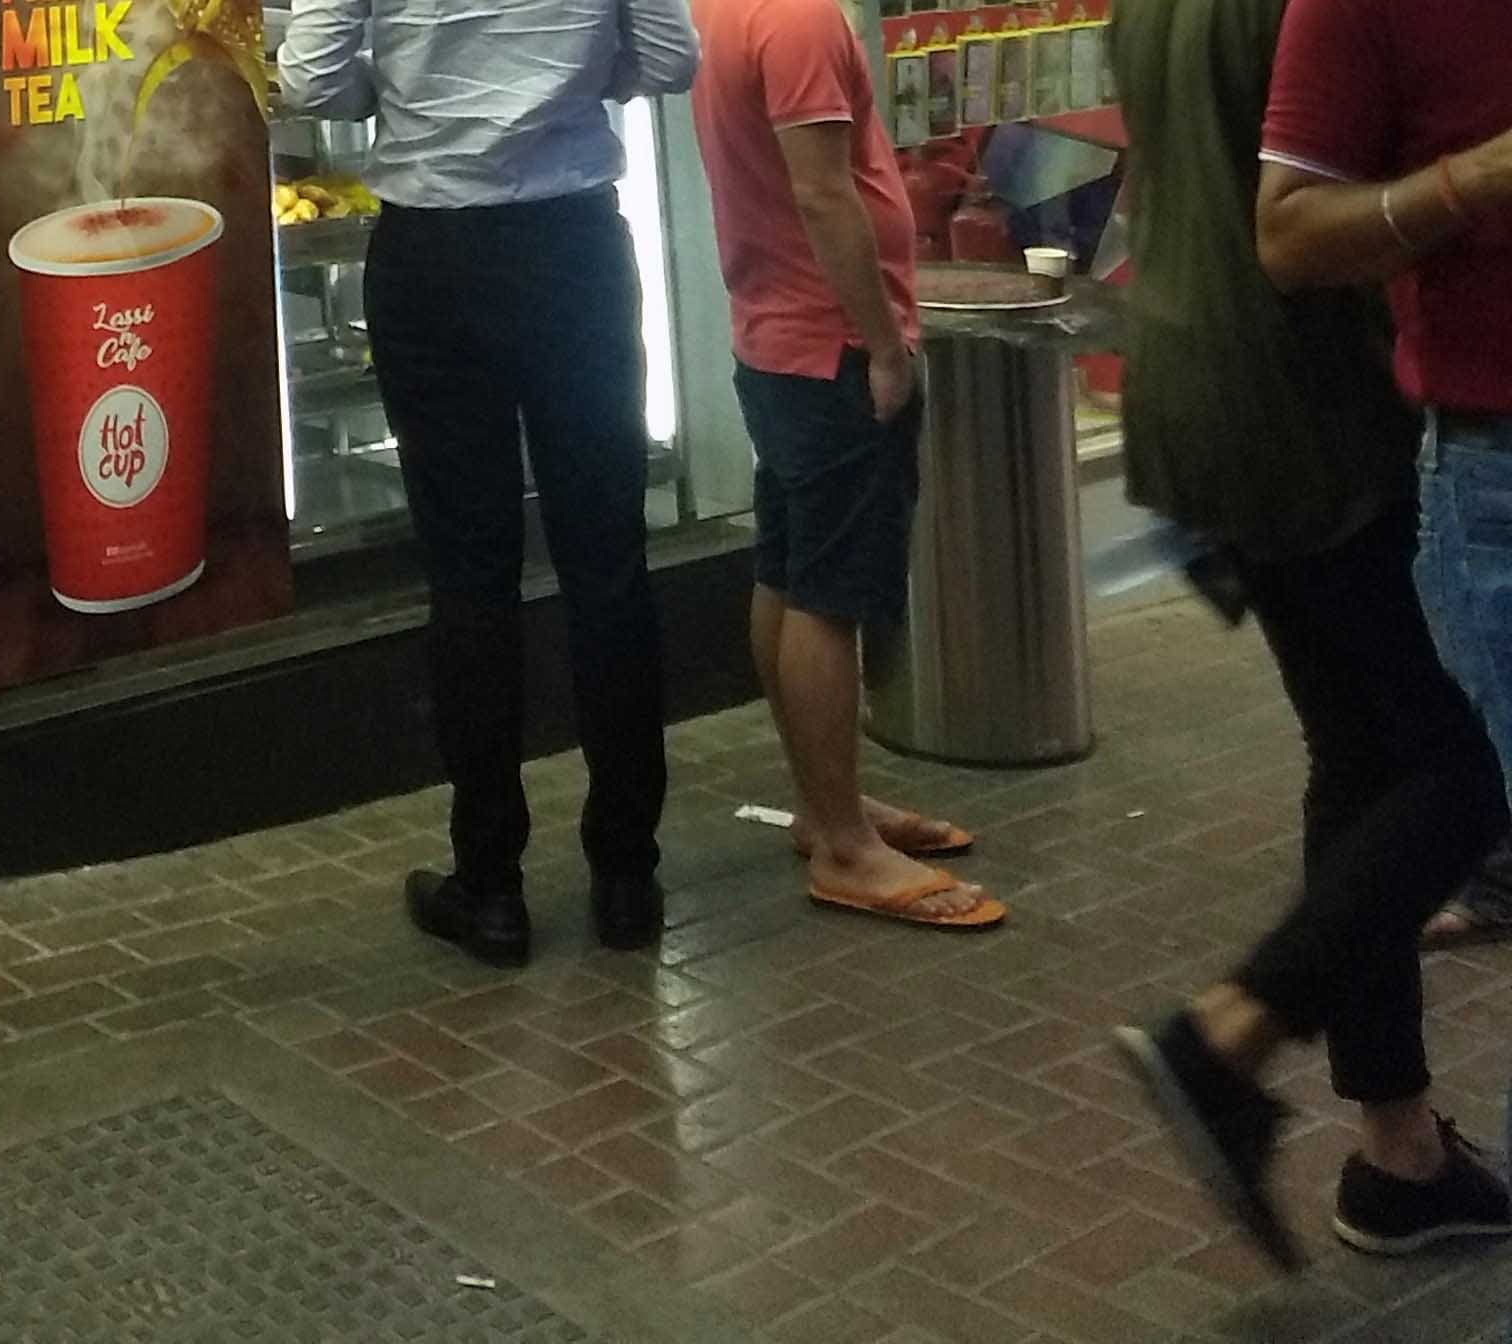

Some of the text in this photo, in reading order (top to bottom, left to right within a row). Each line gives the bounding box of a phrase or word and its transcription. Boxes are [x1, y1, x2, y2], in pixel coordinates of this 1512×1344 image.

[0, 0, 135, 71] MILK
[3, 73, 85, 126] TEA
[92, 302, 154, 332] Lassi
[99, 403, 146, 451] Hot
